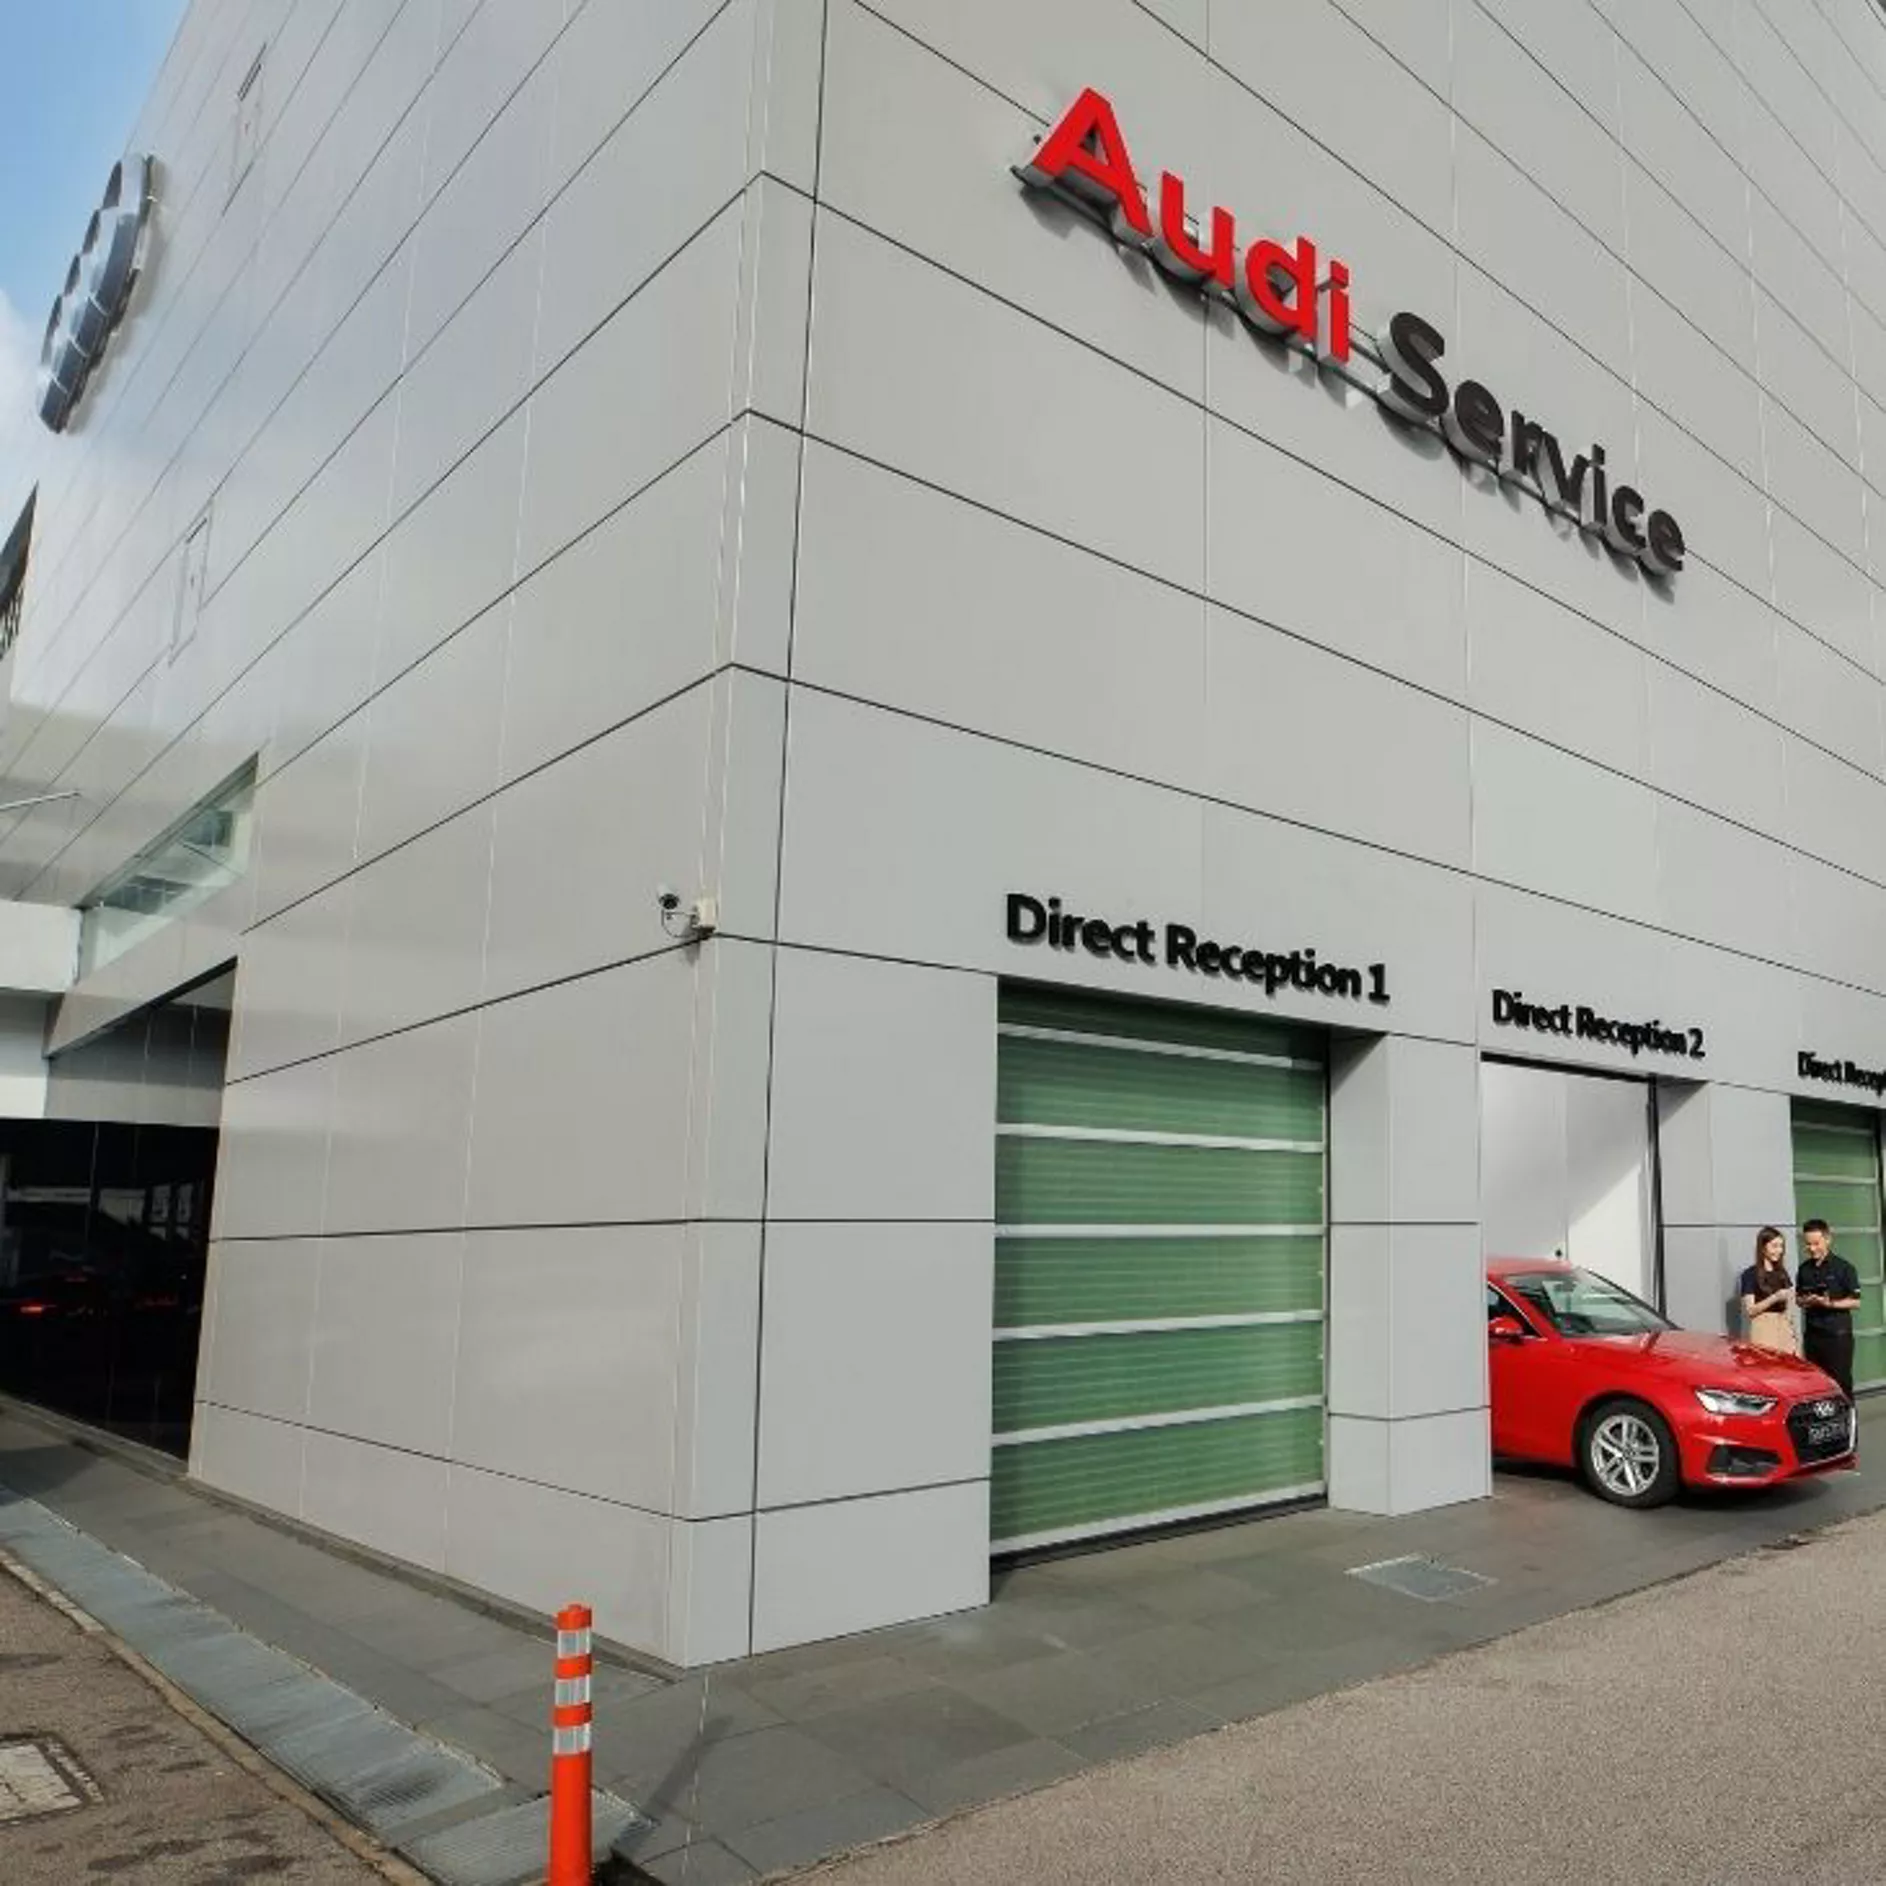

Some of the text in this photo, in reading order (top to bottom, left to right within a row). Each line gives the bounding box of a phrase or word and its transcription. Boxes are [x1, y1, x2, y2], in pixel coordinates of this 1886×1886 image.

[1030, 87, 1685, 573] Audi Service
[1007, 893, 1391, 1003] Direct Reception 1
[1492, 989, 1706, 1058] Direct Reception 2
